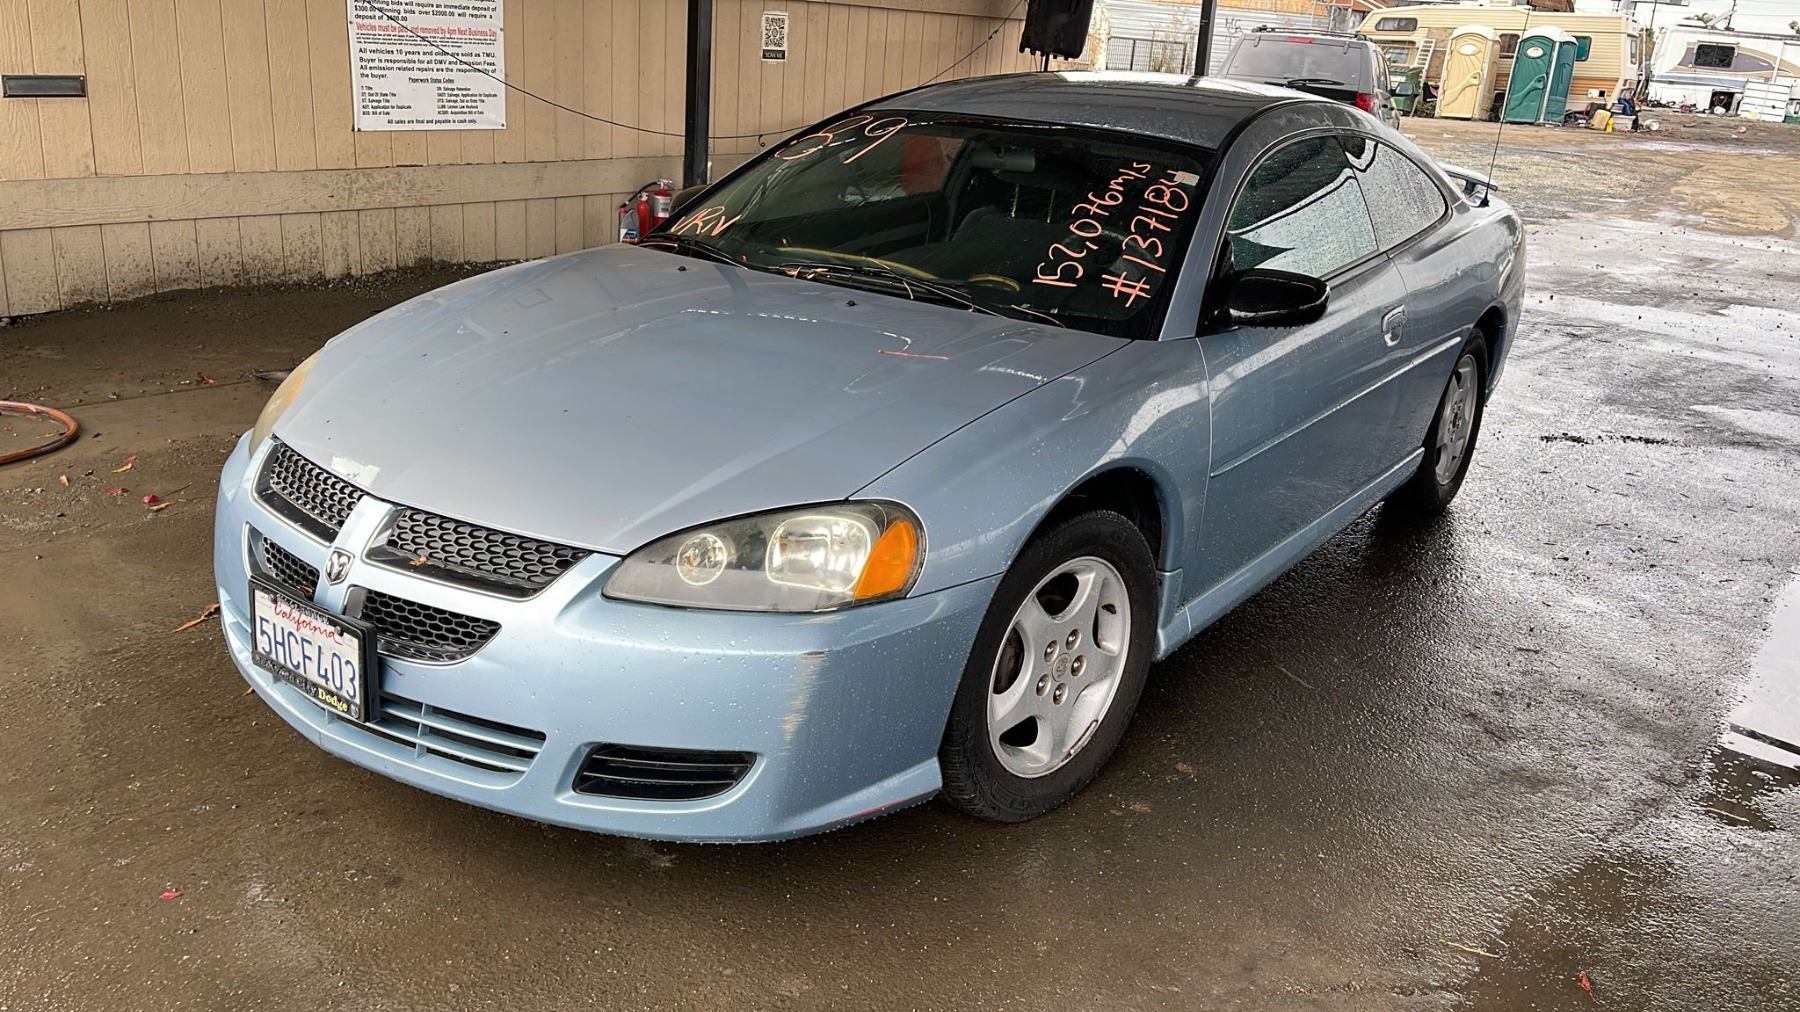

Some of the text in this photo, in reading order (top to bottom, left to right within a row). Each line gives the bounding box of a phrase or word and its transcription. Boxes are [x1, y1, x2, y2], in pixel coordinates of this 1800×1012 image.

[431, 9, 455, 17] $2000.00
[356, 22, 377, 31] Vehicles
[378, 24, 390, 33] must
[420, 26, 440, 35] removed
[440, 27, 447, 36] by
[458, 28, 468, 36] Next
[468, 28, 488, 36] Business
[489, 29, 497, 38] Day
[272, 599, 343, 646] California
[259, 615, 357, 699] 5HCF403
[317, 688, 348, 712] Dodge
